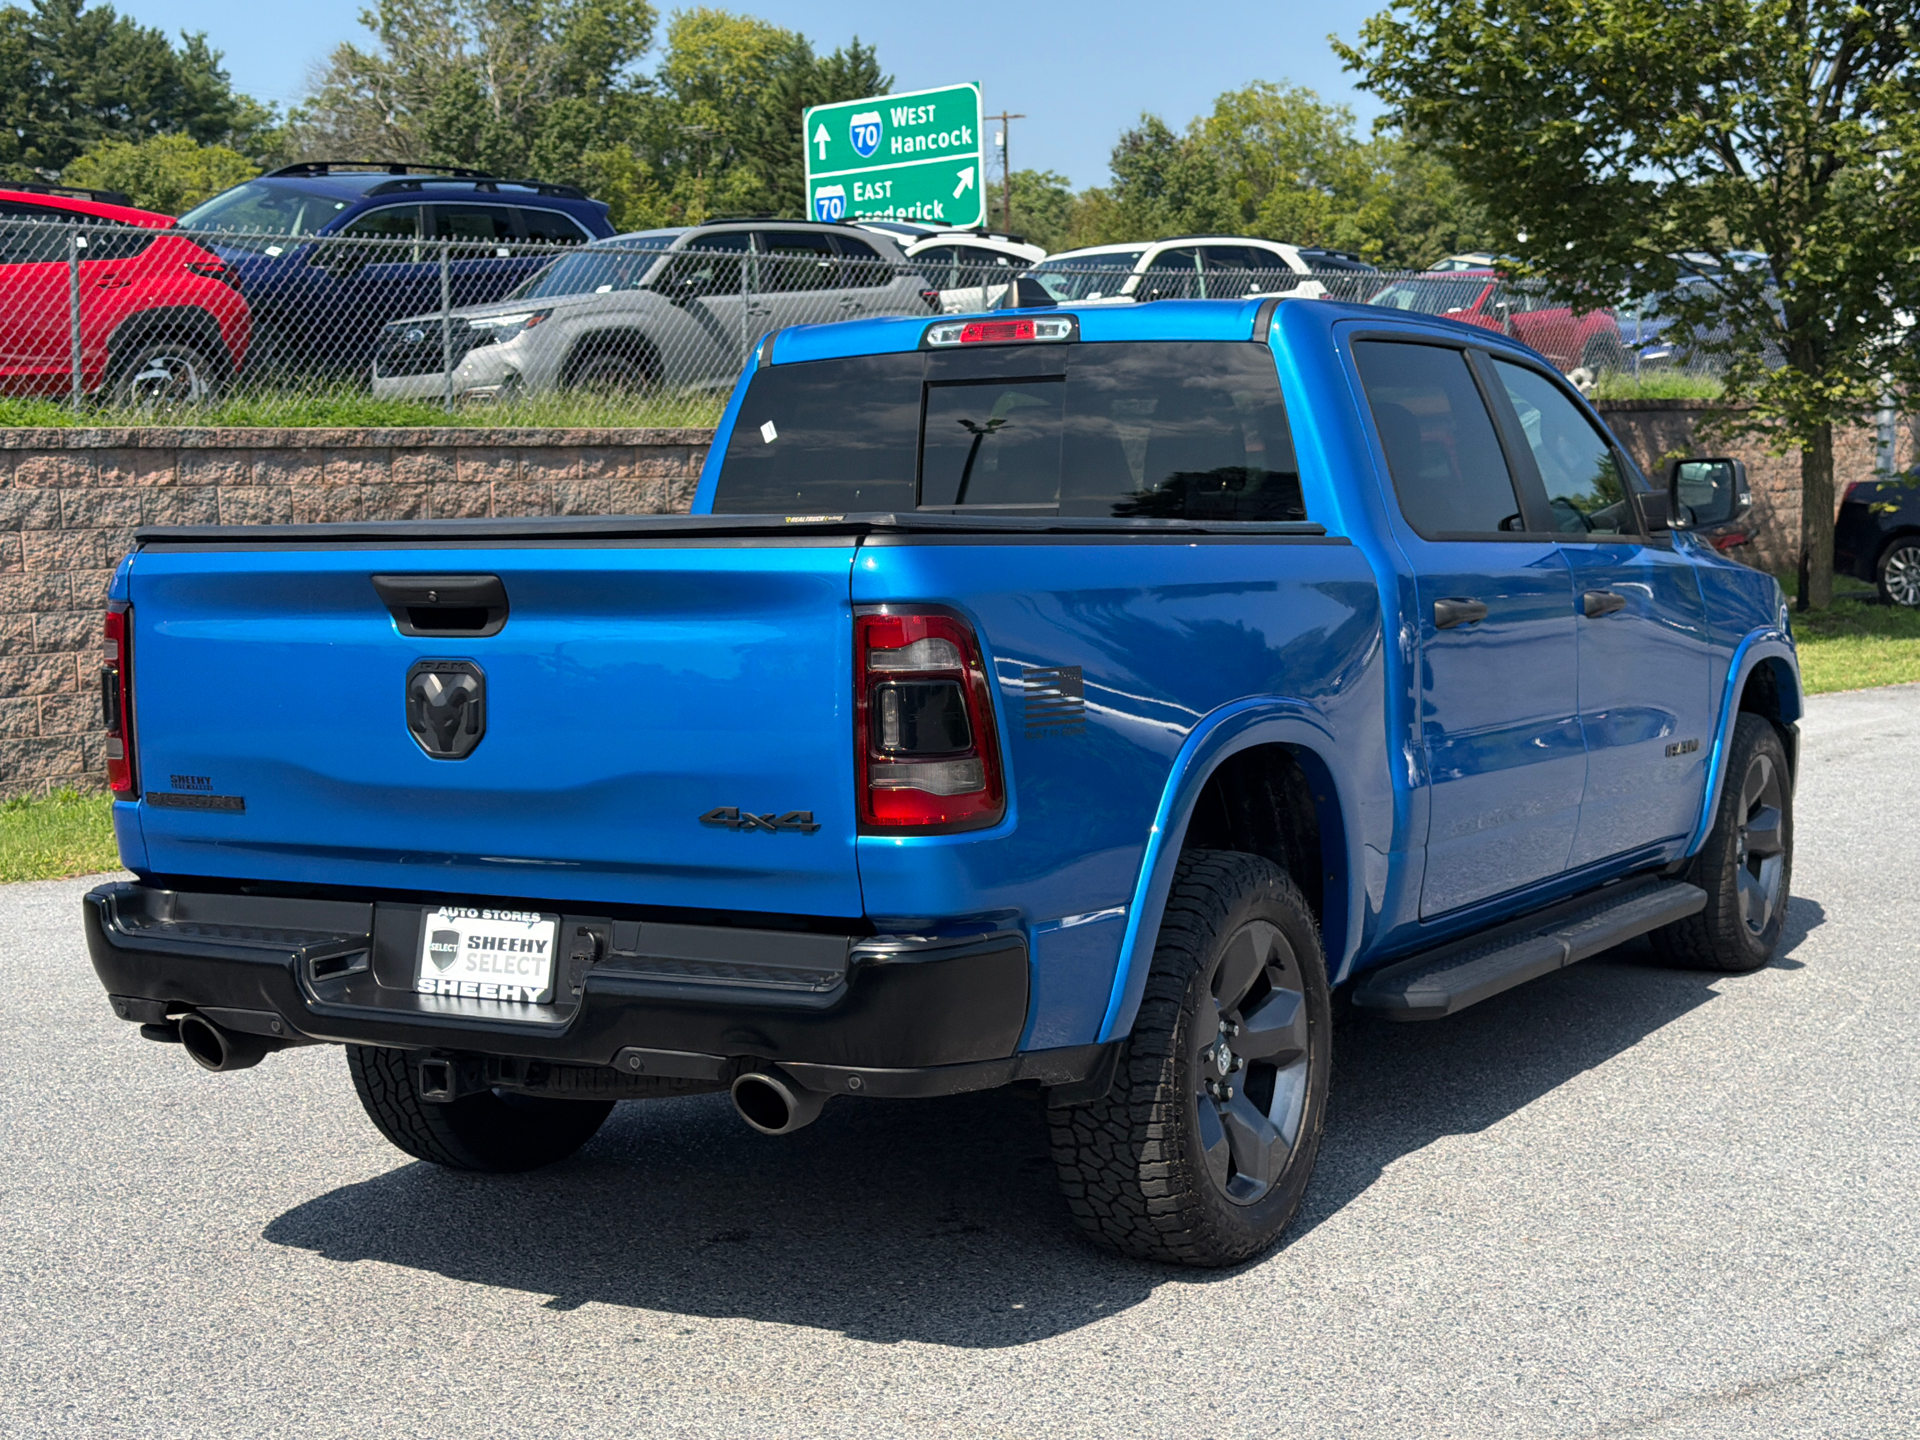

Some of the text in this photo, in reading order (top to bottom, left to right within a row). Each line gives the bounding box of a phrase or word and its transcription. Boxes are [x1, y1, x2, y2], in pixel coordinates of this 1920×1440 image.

[890, 105, 936, 128] WEST
[854, 125, 878, 148] 70
[891, 125, 973, 155] Hancock
[853, 181, 893, 201] EAST
[819, 198, 842, 221] 70
[170, 775, 211, 786] SHEEHY
[437, 906, 541, 923] AUTO STORES
[429, 942, 459, 952] SELECT
[467, 935, 549, 954] SHEEHY
[465, 952, 546, 977] SELECT
[417, 978, 546, 1003] SHEEHY
